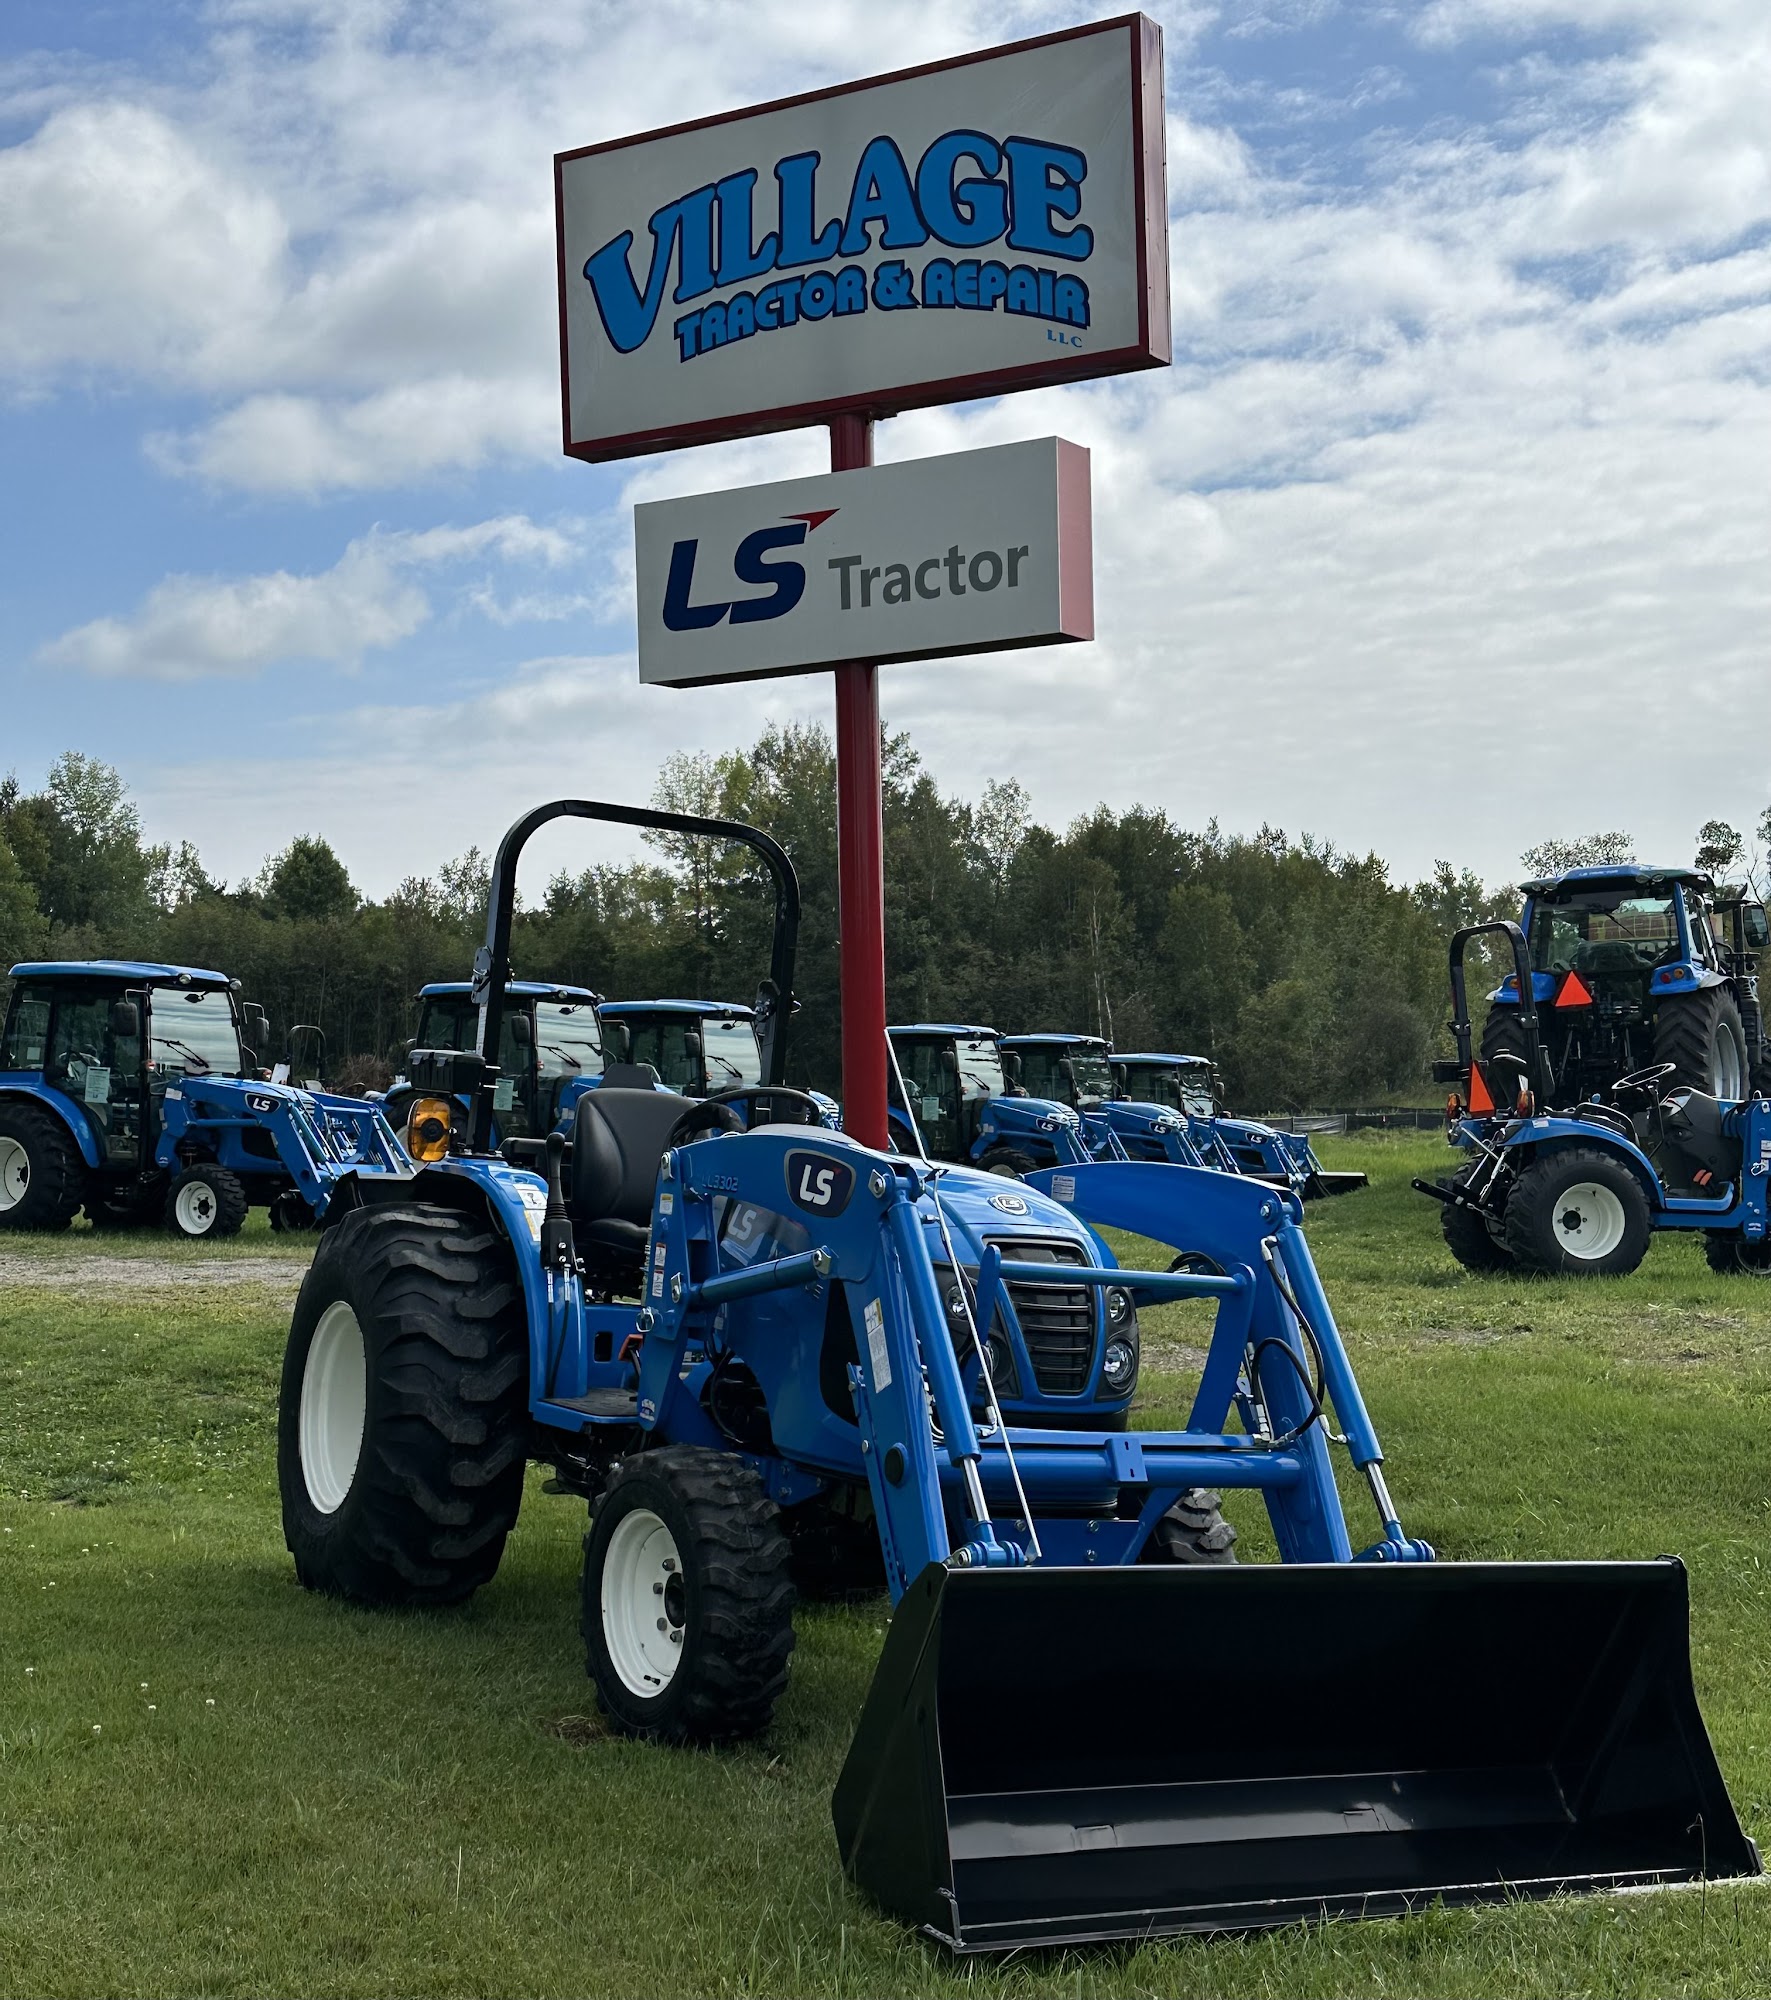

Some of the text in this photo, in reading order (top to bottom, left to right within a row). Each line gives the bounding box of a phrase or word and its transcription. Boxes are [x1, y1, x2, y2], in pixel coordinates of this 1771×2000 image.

[583, 129, 1094, 354] VILLAGE
[674, 257, 1090, 363] TRACTOR & REPAIR
[1047, 329, 1083, 348] LLC
[662, 521, 1029, 631] LS Tractor
[253, 1098, 270, 1111] LS
[1041, 1122, 1054, 1131] LS
[1154, 1125, 1166, 1134] LS
[1251, 1135, 1262, 1143] LS
[702, 1174, 738, 1191] LL3302
[800, 1164, 834, 1205] LS
[728, 1204, 757, 1240] LS
